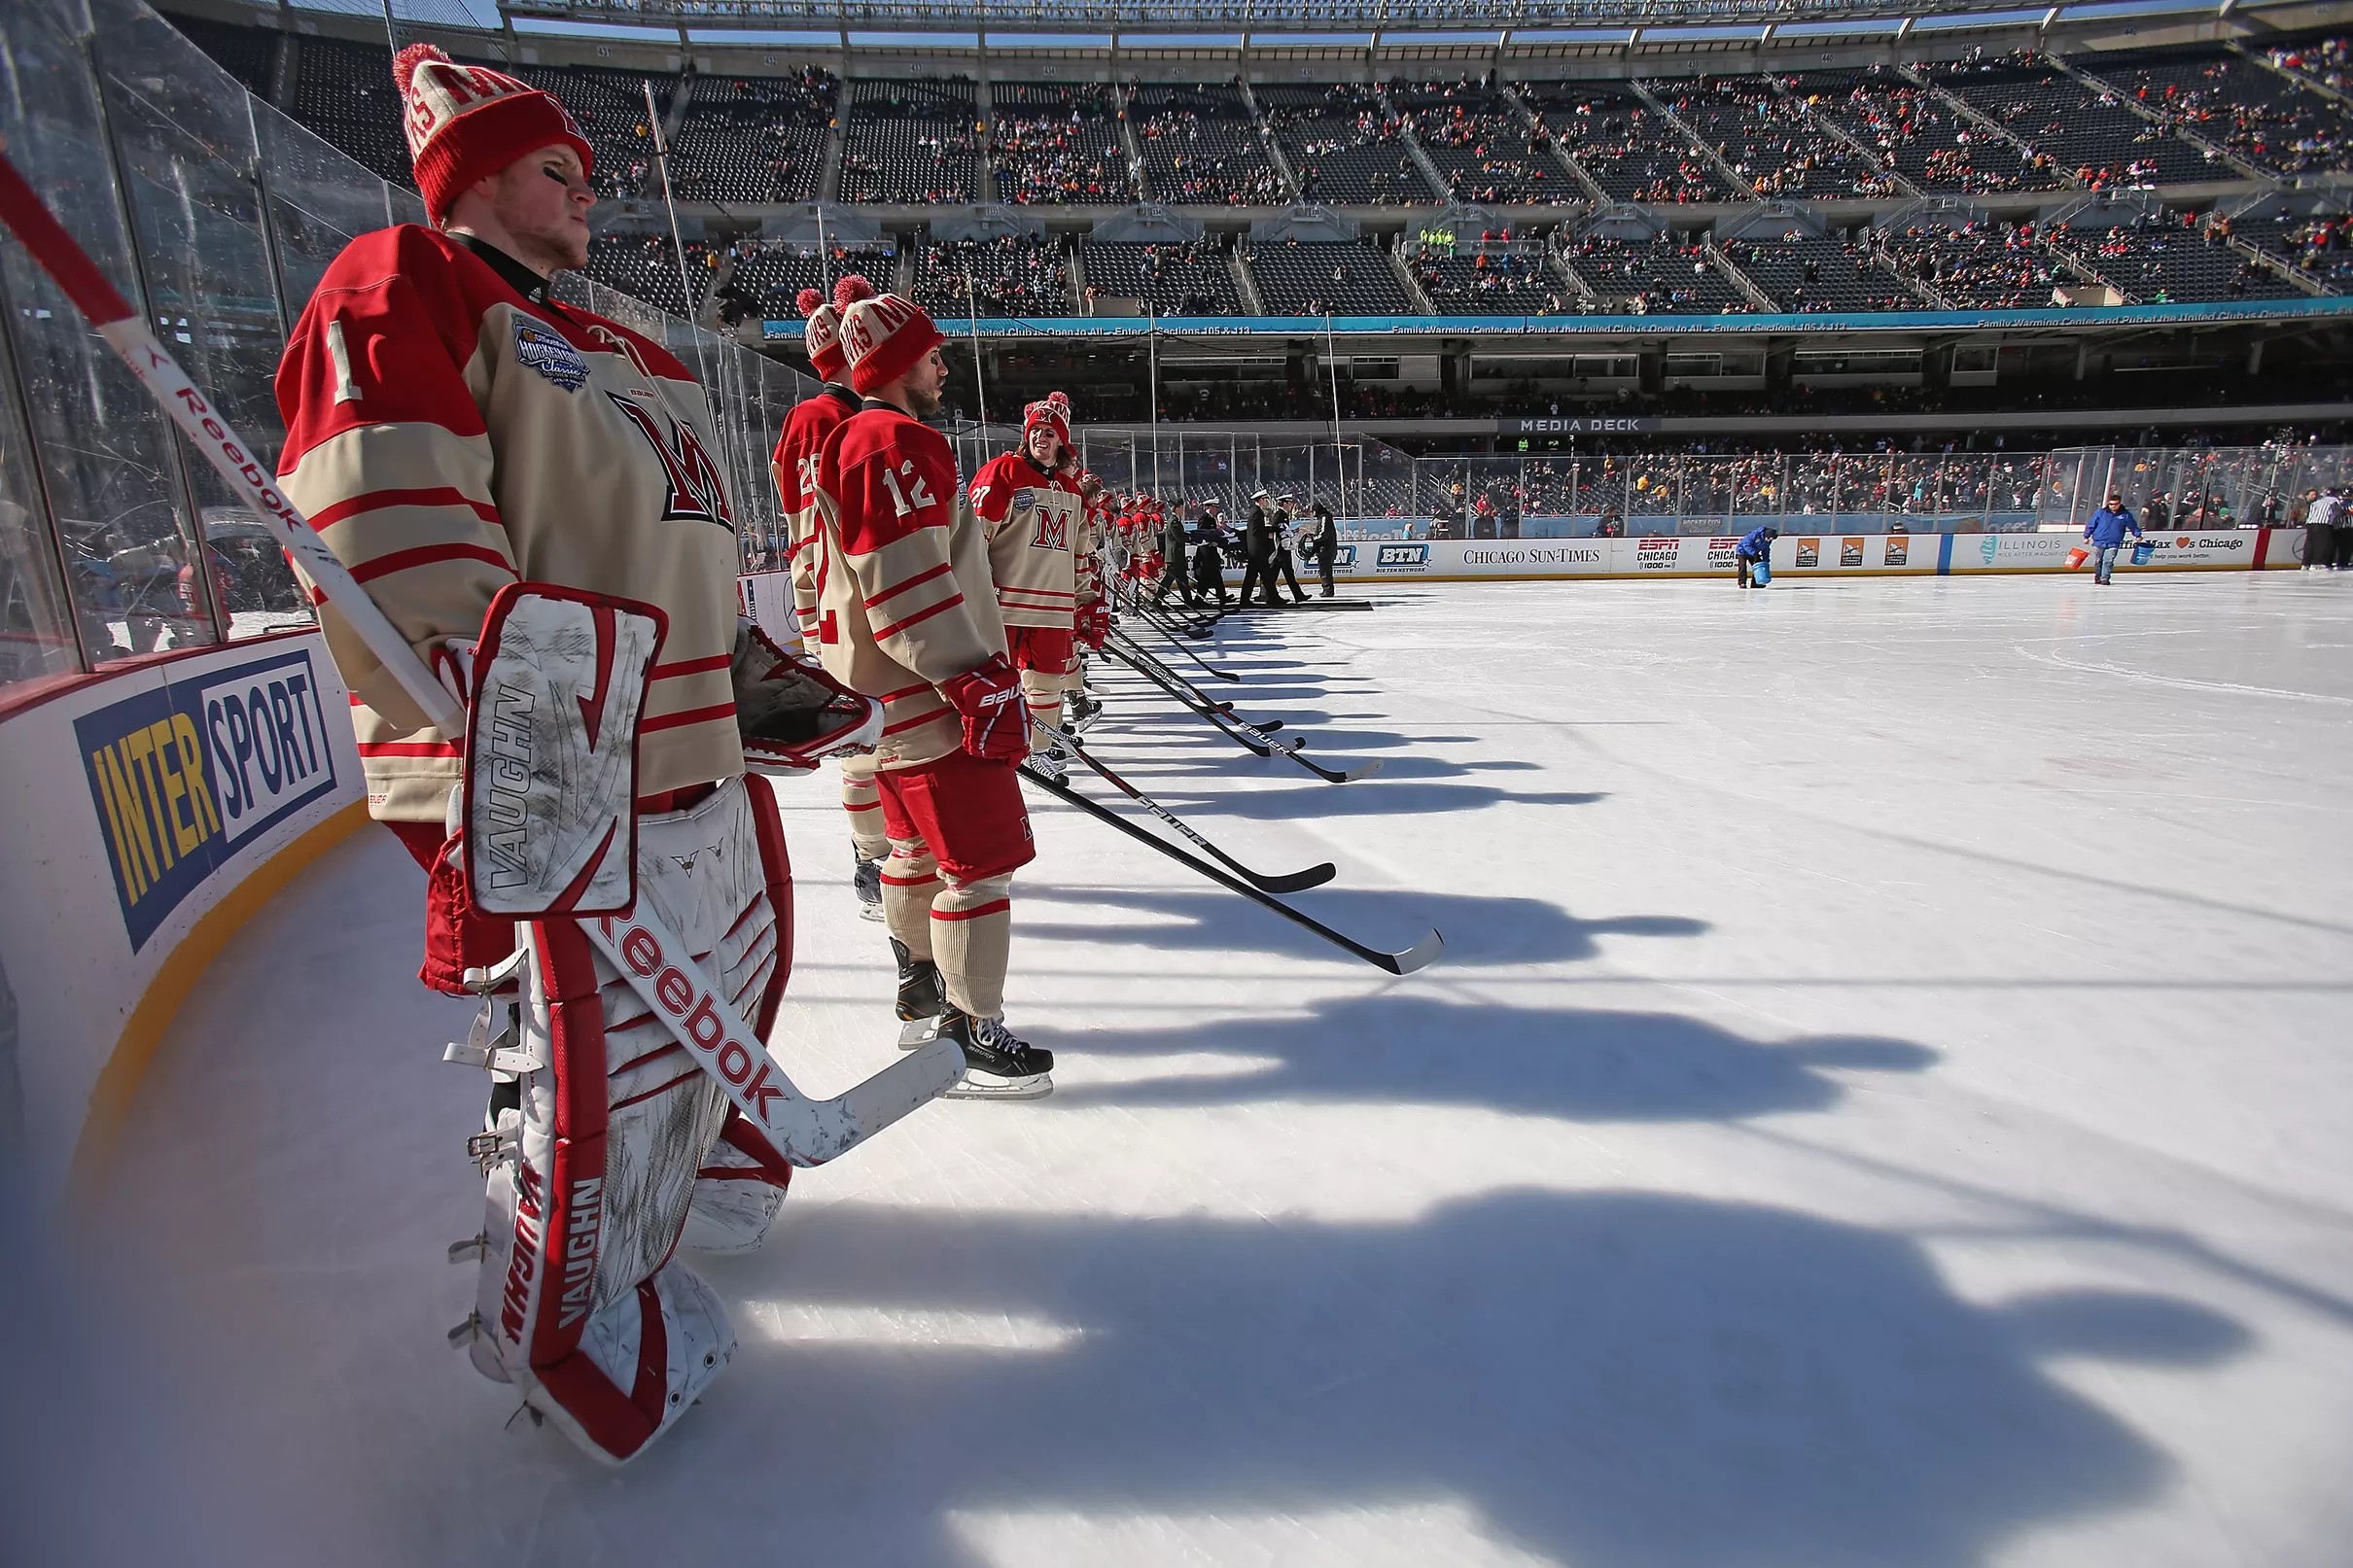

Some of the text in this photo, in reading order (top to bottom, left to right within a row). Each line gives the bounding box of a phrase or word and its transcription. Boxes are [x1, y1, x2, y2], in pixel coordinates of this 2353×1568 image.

[597, 46, 611, 57] 431
[1391, 325, 1424, 334] Family
[1425, 325, 1469, 334] Warming
[1471, 325, 1504, 334] Center
[1506, 325, 1525, 334] and
[1528, 325, 1547, 333] Pub
[1562, 324, 1577, 333] the
[1579, 324, 1612, 333] United
[1614, 324, 1636, 333] Club
[1649, 324, 1675, 333] Open
[1713, 324, 1739, 332] Enter
[1754, 323, 1797, 332] Sections
[1800, 323, 1817, 331] 105
[1977, 319, 2012, 329] Family
[2014, 318, 2059, 328] Warming
[2061, 317, 2095, 327] Center
[2099, 316, 2119, 325] and
[2123, 315, 2143, 324] Pub
[2160, 314, 2177, 323] the
[2179, 312, 2216, 322] United
[2218, 311, 2244, 321] Club
[1009, 327, 1033, 336] Club
[1046, 327, 1075, 336] Open
[1115, 327, 1141, 335] Enter
[1157, 327, 1201, 335] Sections
[1204, 327, 1220, 335] 105
[325, 320, 363, 405] 1
[542, 357, 581, 375] Classic
[1520, 419, 1639, 432] MEDIA DECK
[175, 387, 302, 533] Reebok
[604, 390, 736, 535] M
[882, 459, 937, 518] 12
[971, 485, 991, 509] 27
[1029, 504, 1073, 552] M
[1638, 539, 1680, 550] ESPN
[1708, 538, 1739, 550] ESP
[1998, 540, 2061, 550] ILLINOIS
[2198, 539, 2243, 550] Chicago
[1381, 547, 1423, 563] BTN
[1463, 548, 1600, 565] CHICAGO SUN-TIMES
[1636, 551, 1678, 562] CHICAGO
[1707, 550, 1738, 561] CHICA
[978, 684, 1023, 709] BAU
[489, 683, 537, 890] VAUGHN
[557, 1176, 603, 1330] VAUGHN
